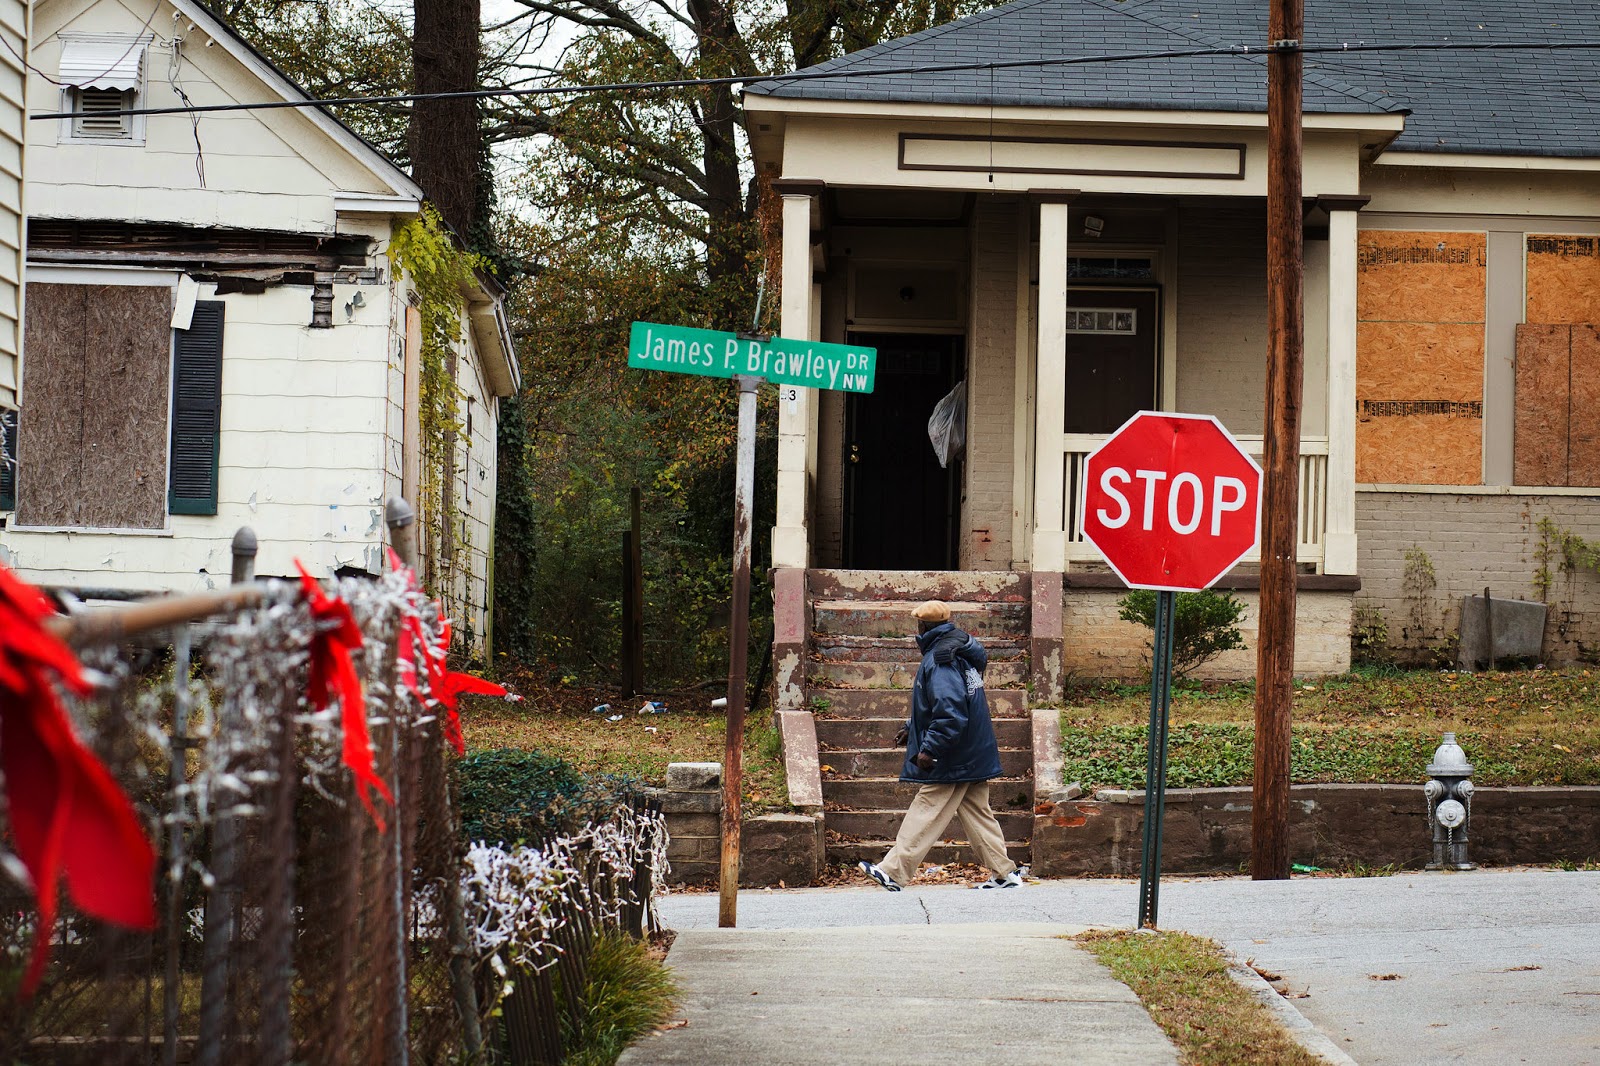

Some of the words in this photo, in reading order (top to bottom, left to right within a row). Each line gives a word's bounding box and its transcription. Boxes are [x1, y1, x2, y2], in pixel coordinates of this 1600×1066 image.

[637, 329, 714, 367] James
[724, 339, 738, 370] P.
[749, 341, 841, 390] Brawley
[846, 353, 869, 371] DR
[842, 373, 868, 391] NW
[1096, 466, 1247, 537] STOP
